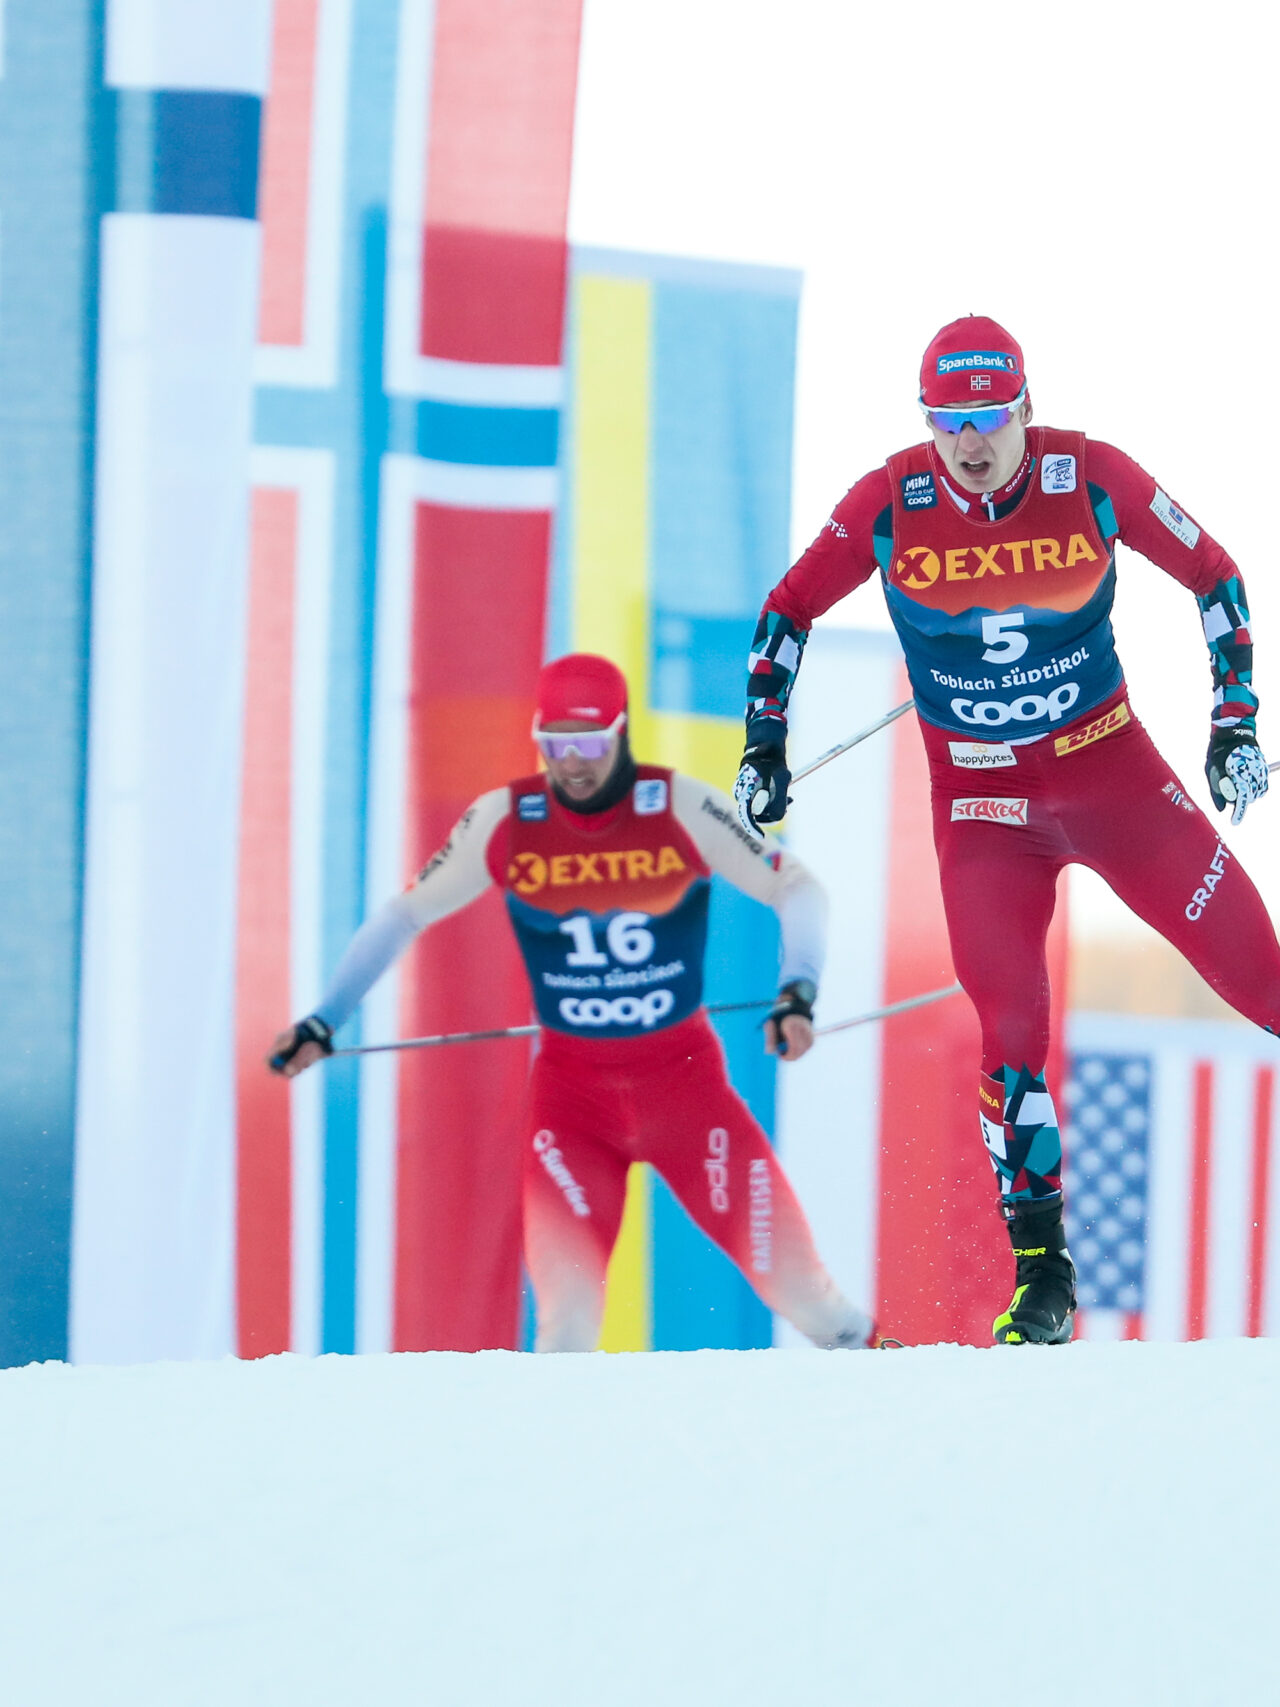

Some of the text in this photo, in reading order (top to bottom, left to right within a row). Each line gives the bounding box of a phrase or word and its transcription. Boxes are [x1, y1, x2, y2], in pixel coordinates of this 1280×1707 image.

[939, 355, 1004, 371] SpareBank
[908, 496, 933, 505] coop
[1150, 502, 1195, 549] TORGHATTEN
[945, 533, 1098, 581] EXTRA
[981, 612, 1029, 664] 5
[930, 669, 996, 691] Toblach
[950, 682, 1081, 726] coop
[1066, 711, 1122, 749] DHL
[954, 752, 1013, 766] happybytes
[953, 799, 1026, 824] STAYER
[551, 846, 686, 885] EXTRA
[1185, 843, 1230, 921] CRAFT
[558, 912, 655, 967] 16
[558, 989, 675, 1028] coop
[704, 1127, 730, 1213] odlo
